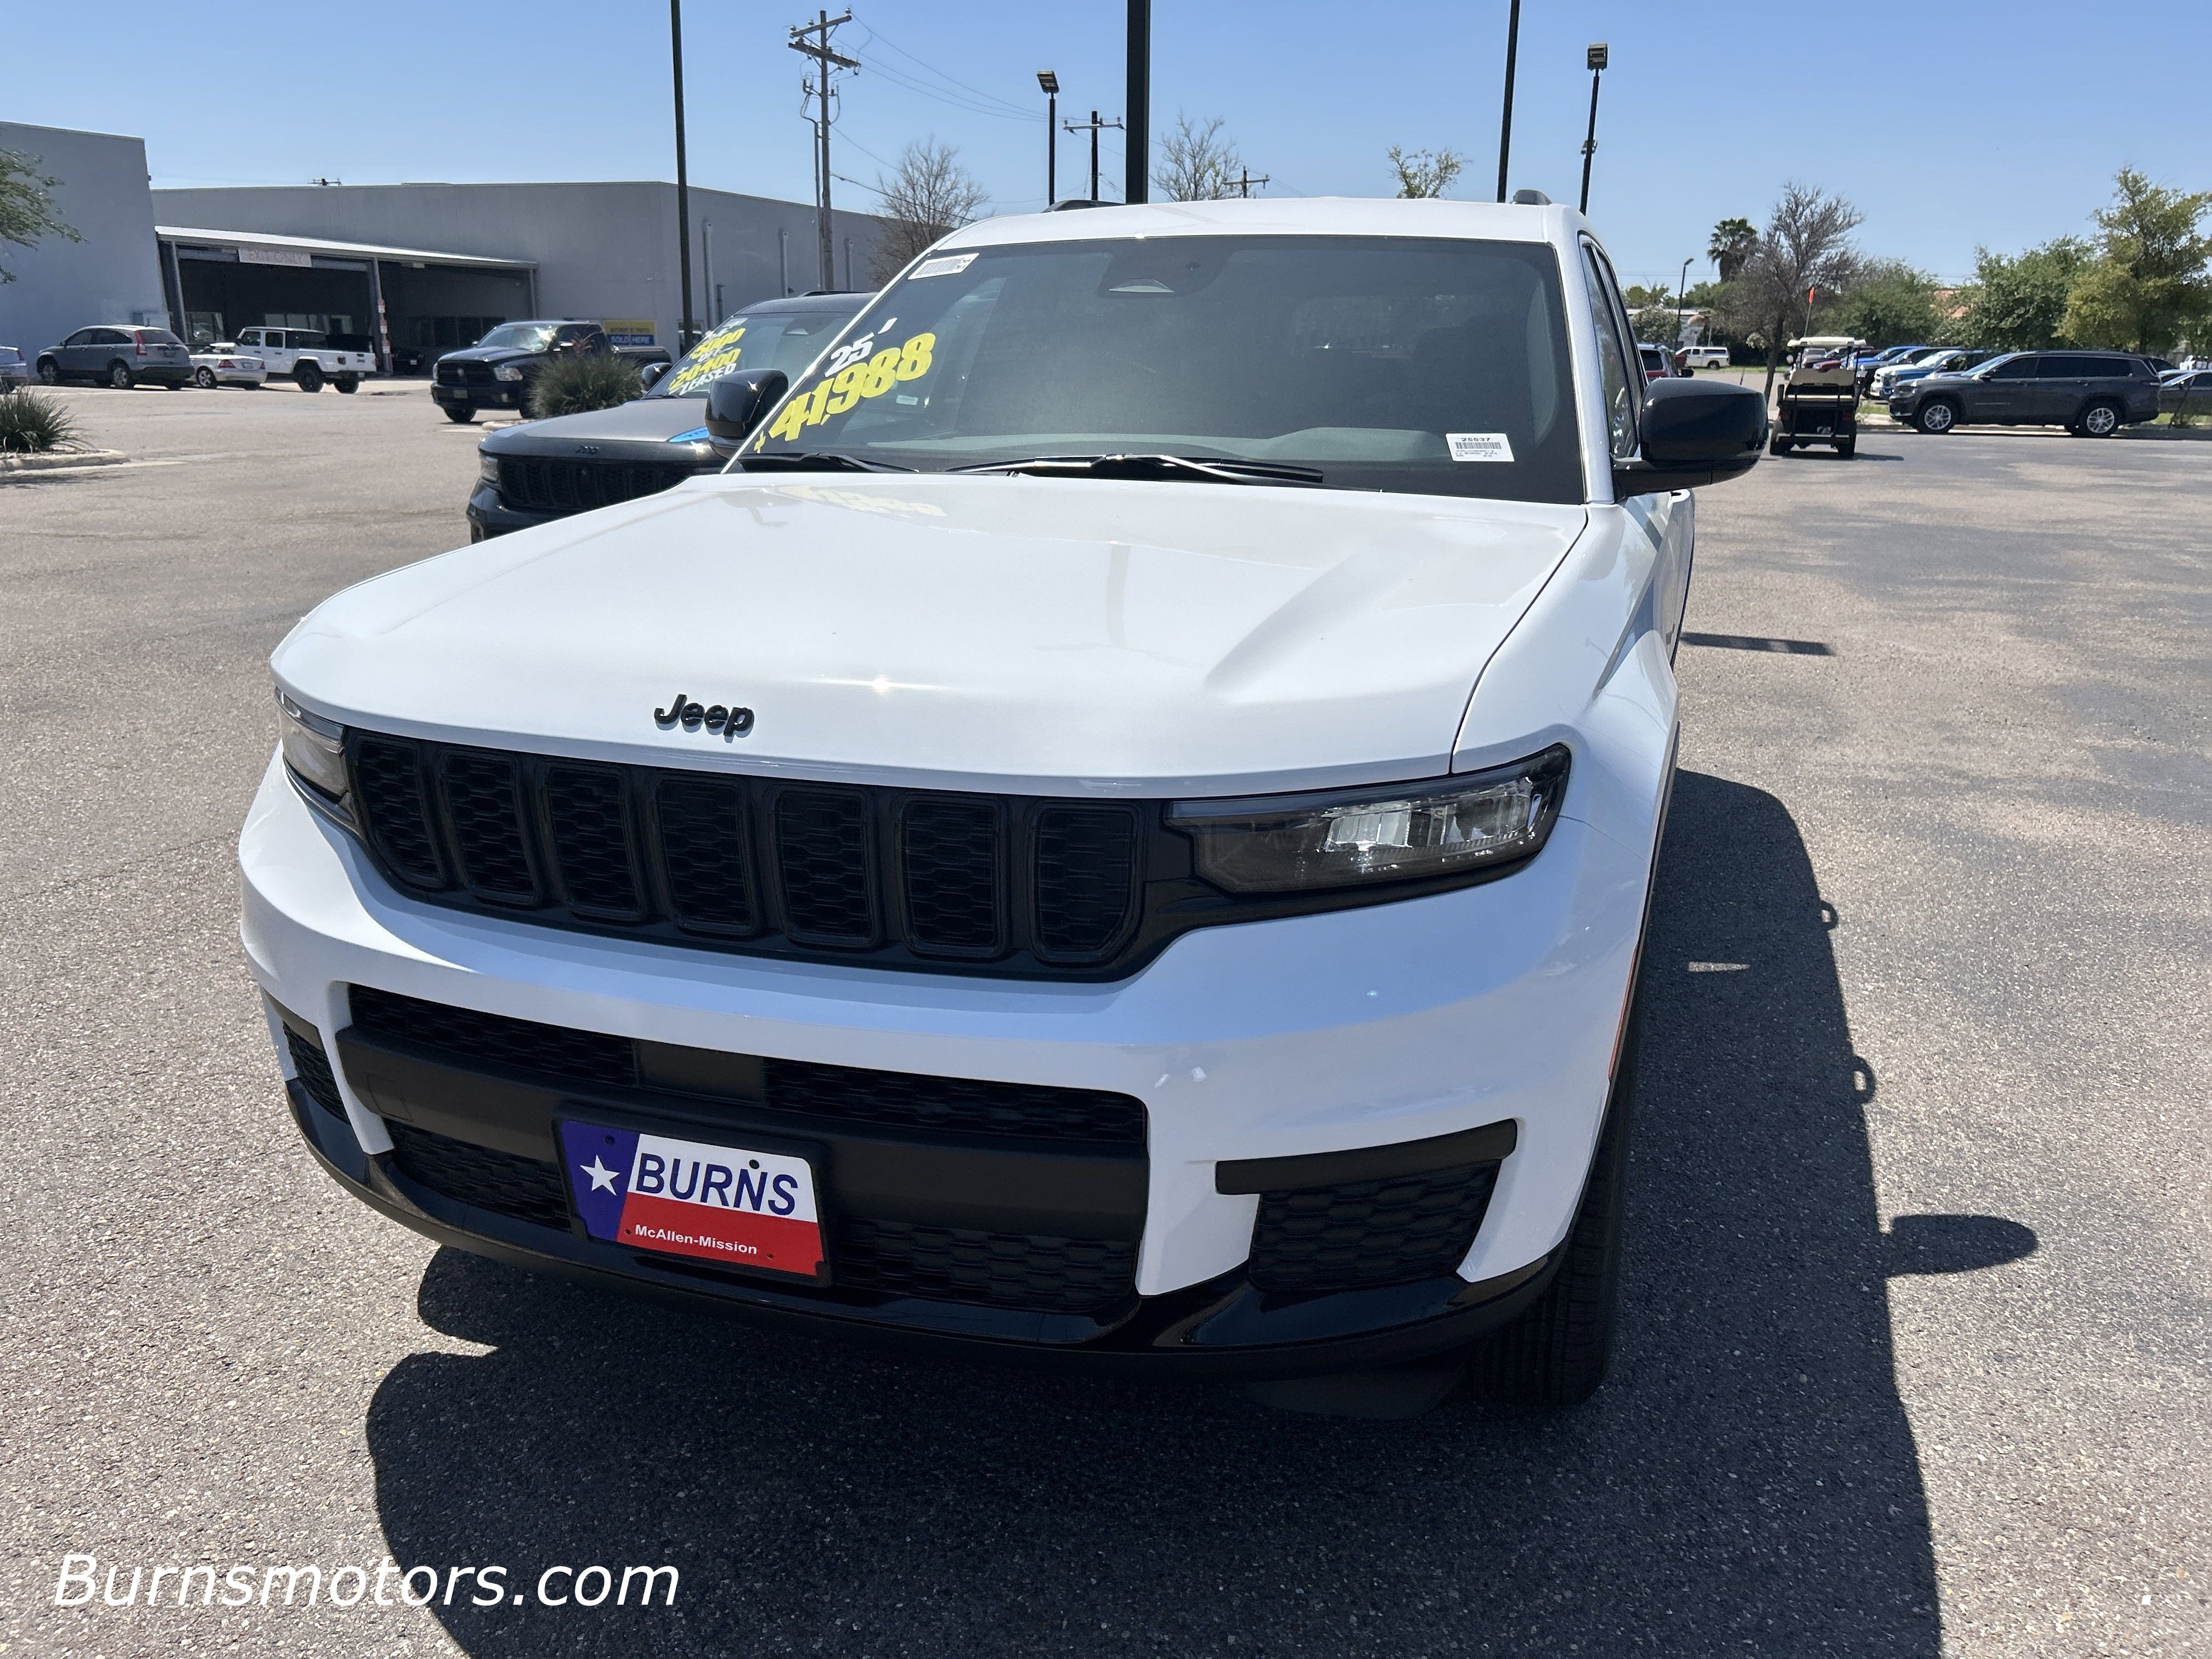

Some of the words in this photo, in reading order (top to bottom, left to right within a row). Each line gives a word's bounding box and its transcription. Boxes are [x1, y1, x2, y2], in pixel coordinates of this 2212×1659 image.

[653, 693, 755, 737] Jeep
[635, 1153, 798, 1216] BURNS
[635, 1224, 758, 1255] McAllen-Mission
